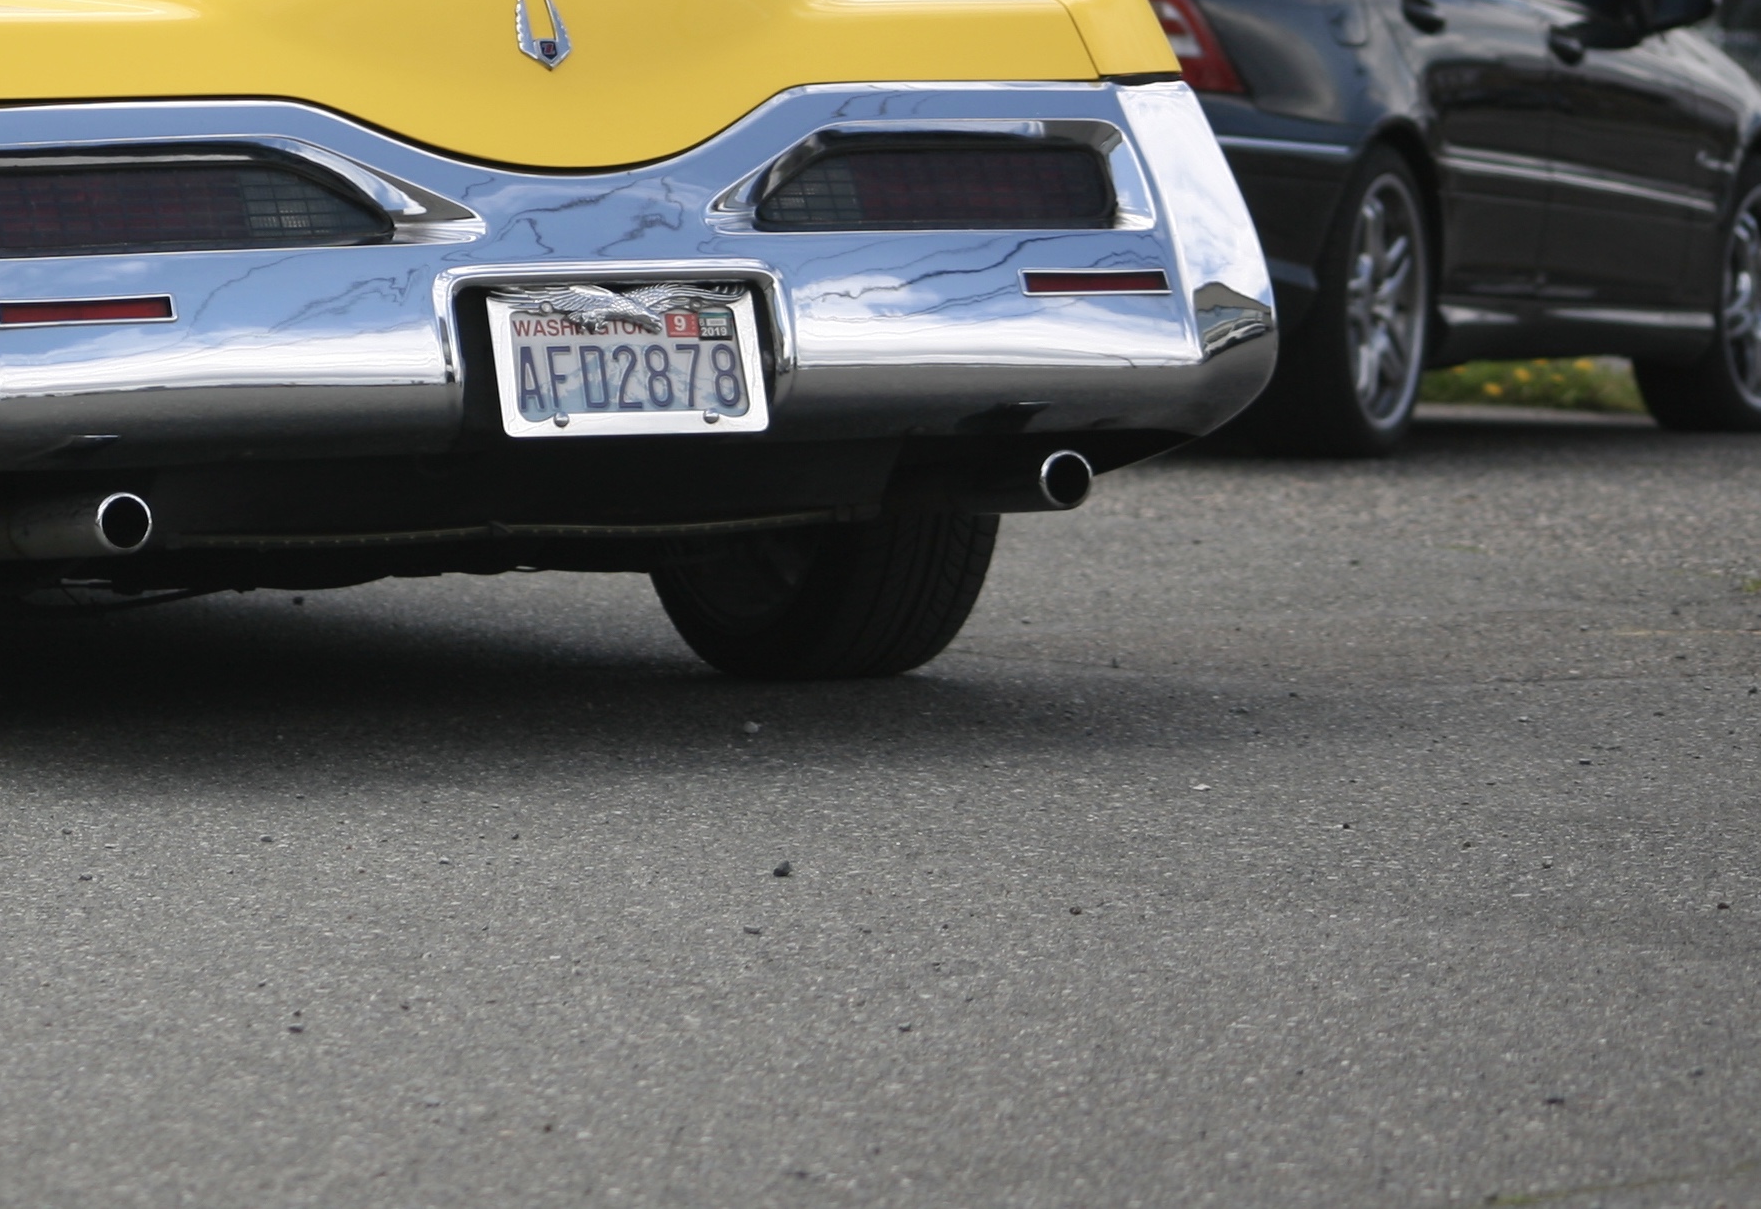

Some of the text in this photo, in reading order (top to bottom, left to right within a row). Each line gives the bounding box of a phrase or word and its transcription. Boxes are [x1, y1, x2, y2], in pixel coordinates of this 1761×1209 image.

[513, 319, 653, 338] WASHIGTO
[673, 315, 686, 331] 9
[701, 327, 727, 336] 2019
[519, 344, 740, 410] AFD2878
